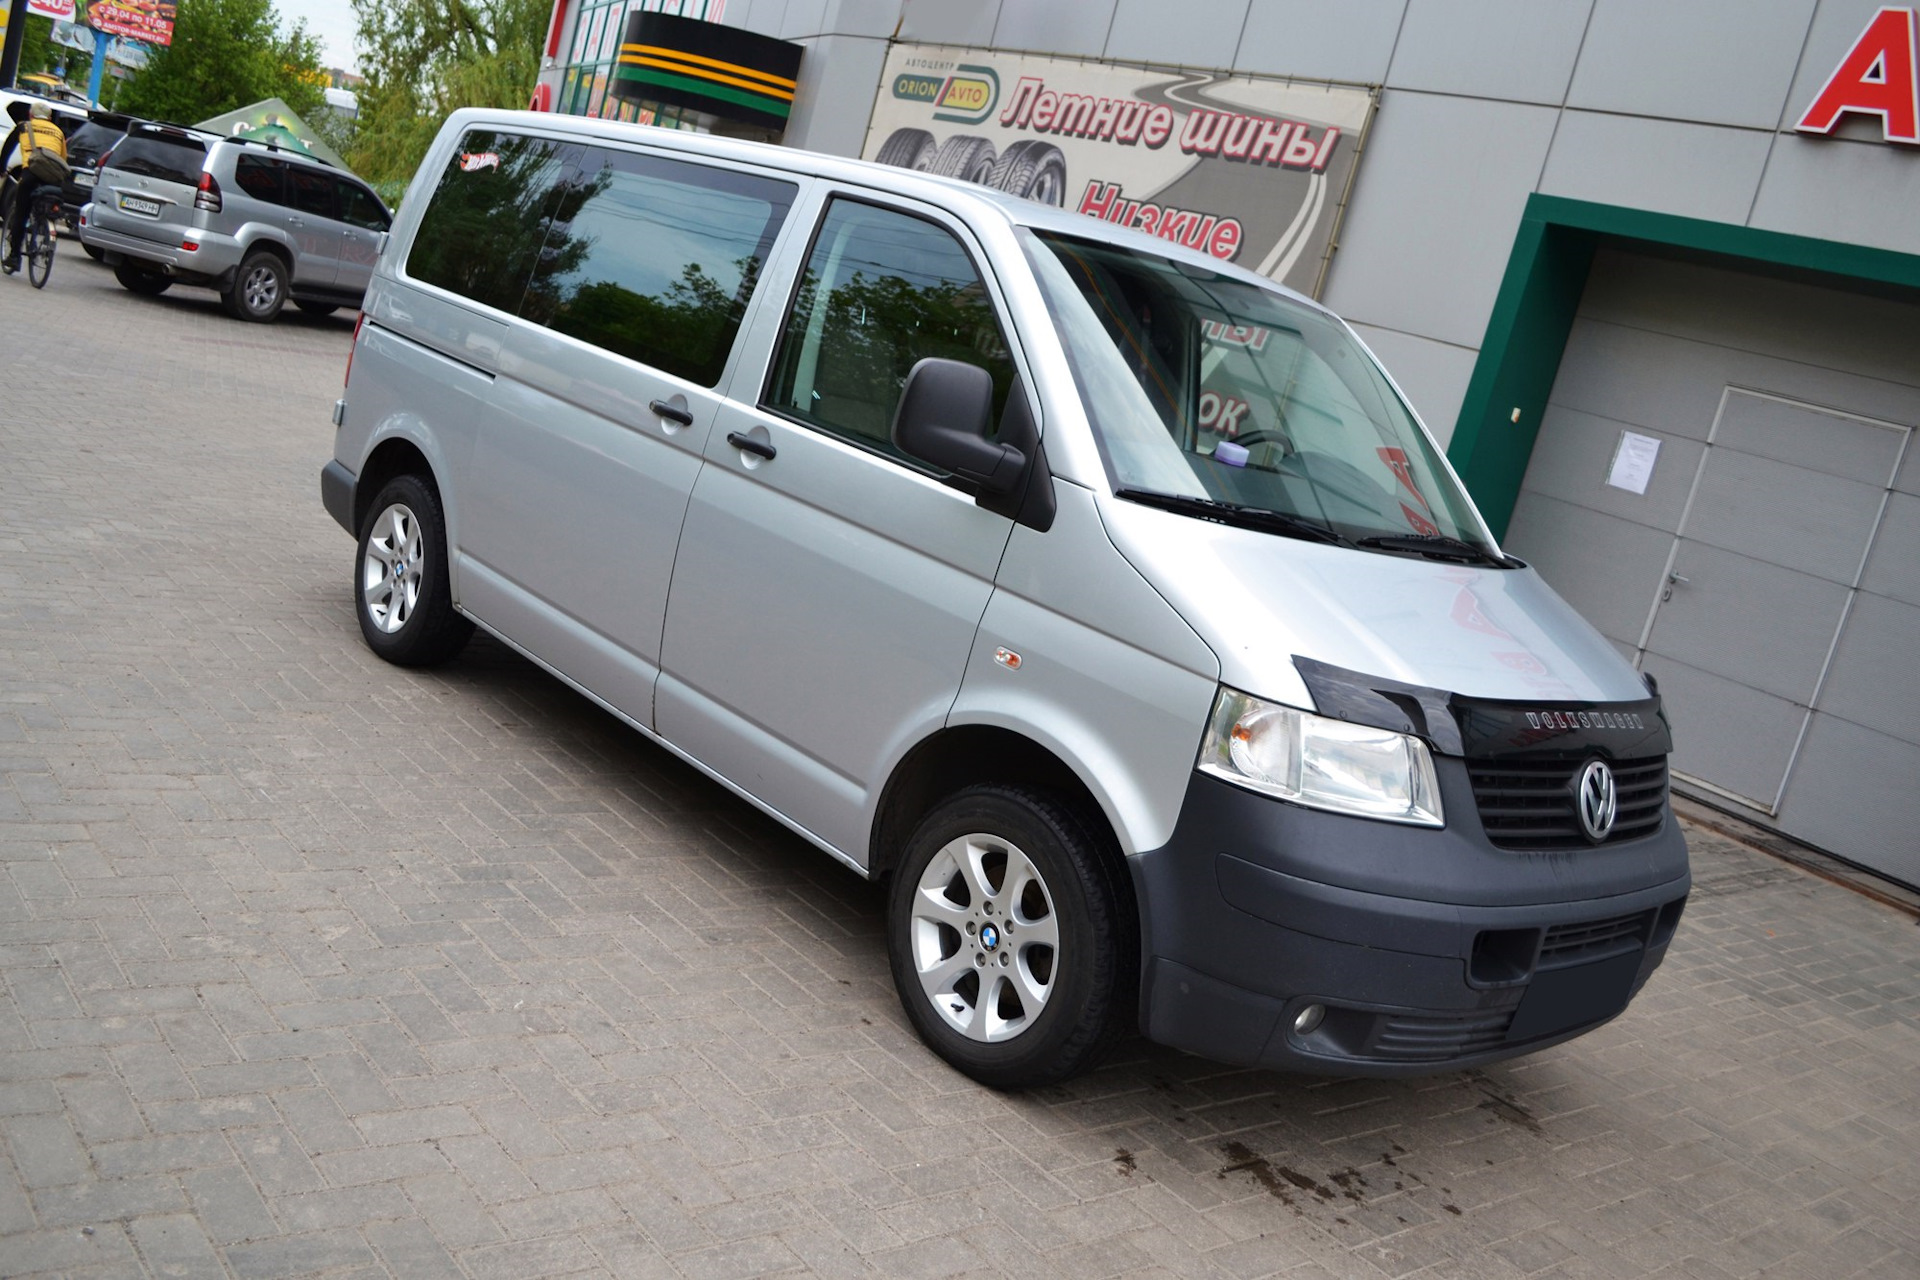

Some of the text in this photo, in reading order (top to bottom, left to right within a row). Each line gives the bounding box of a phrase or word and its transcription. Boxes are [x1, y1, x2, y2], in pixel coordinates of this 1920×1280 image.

[905, 58, 955, 71] АВТОЦЕНТР
[898, 79, 983, 102] ORION AVTO
[999, 76, 1342, 171] Летние шины
[1077, 179, 1244, 262] Низкие
[1525, 711, 1644, 729] VOLKSWAGEN
